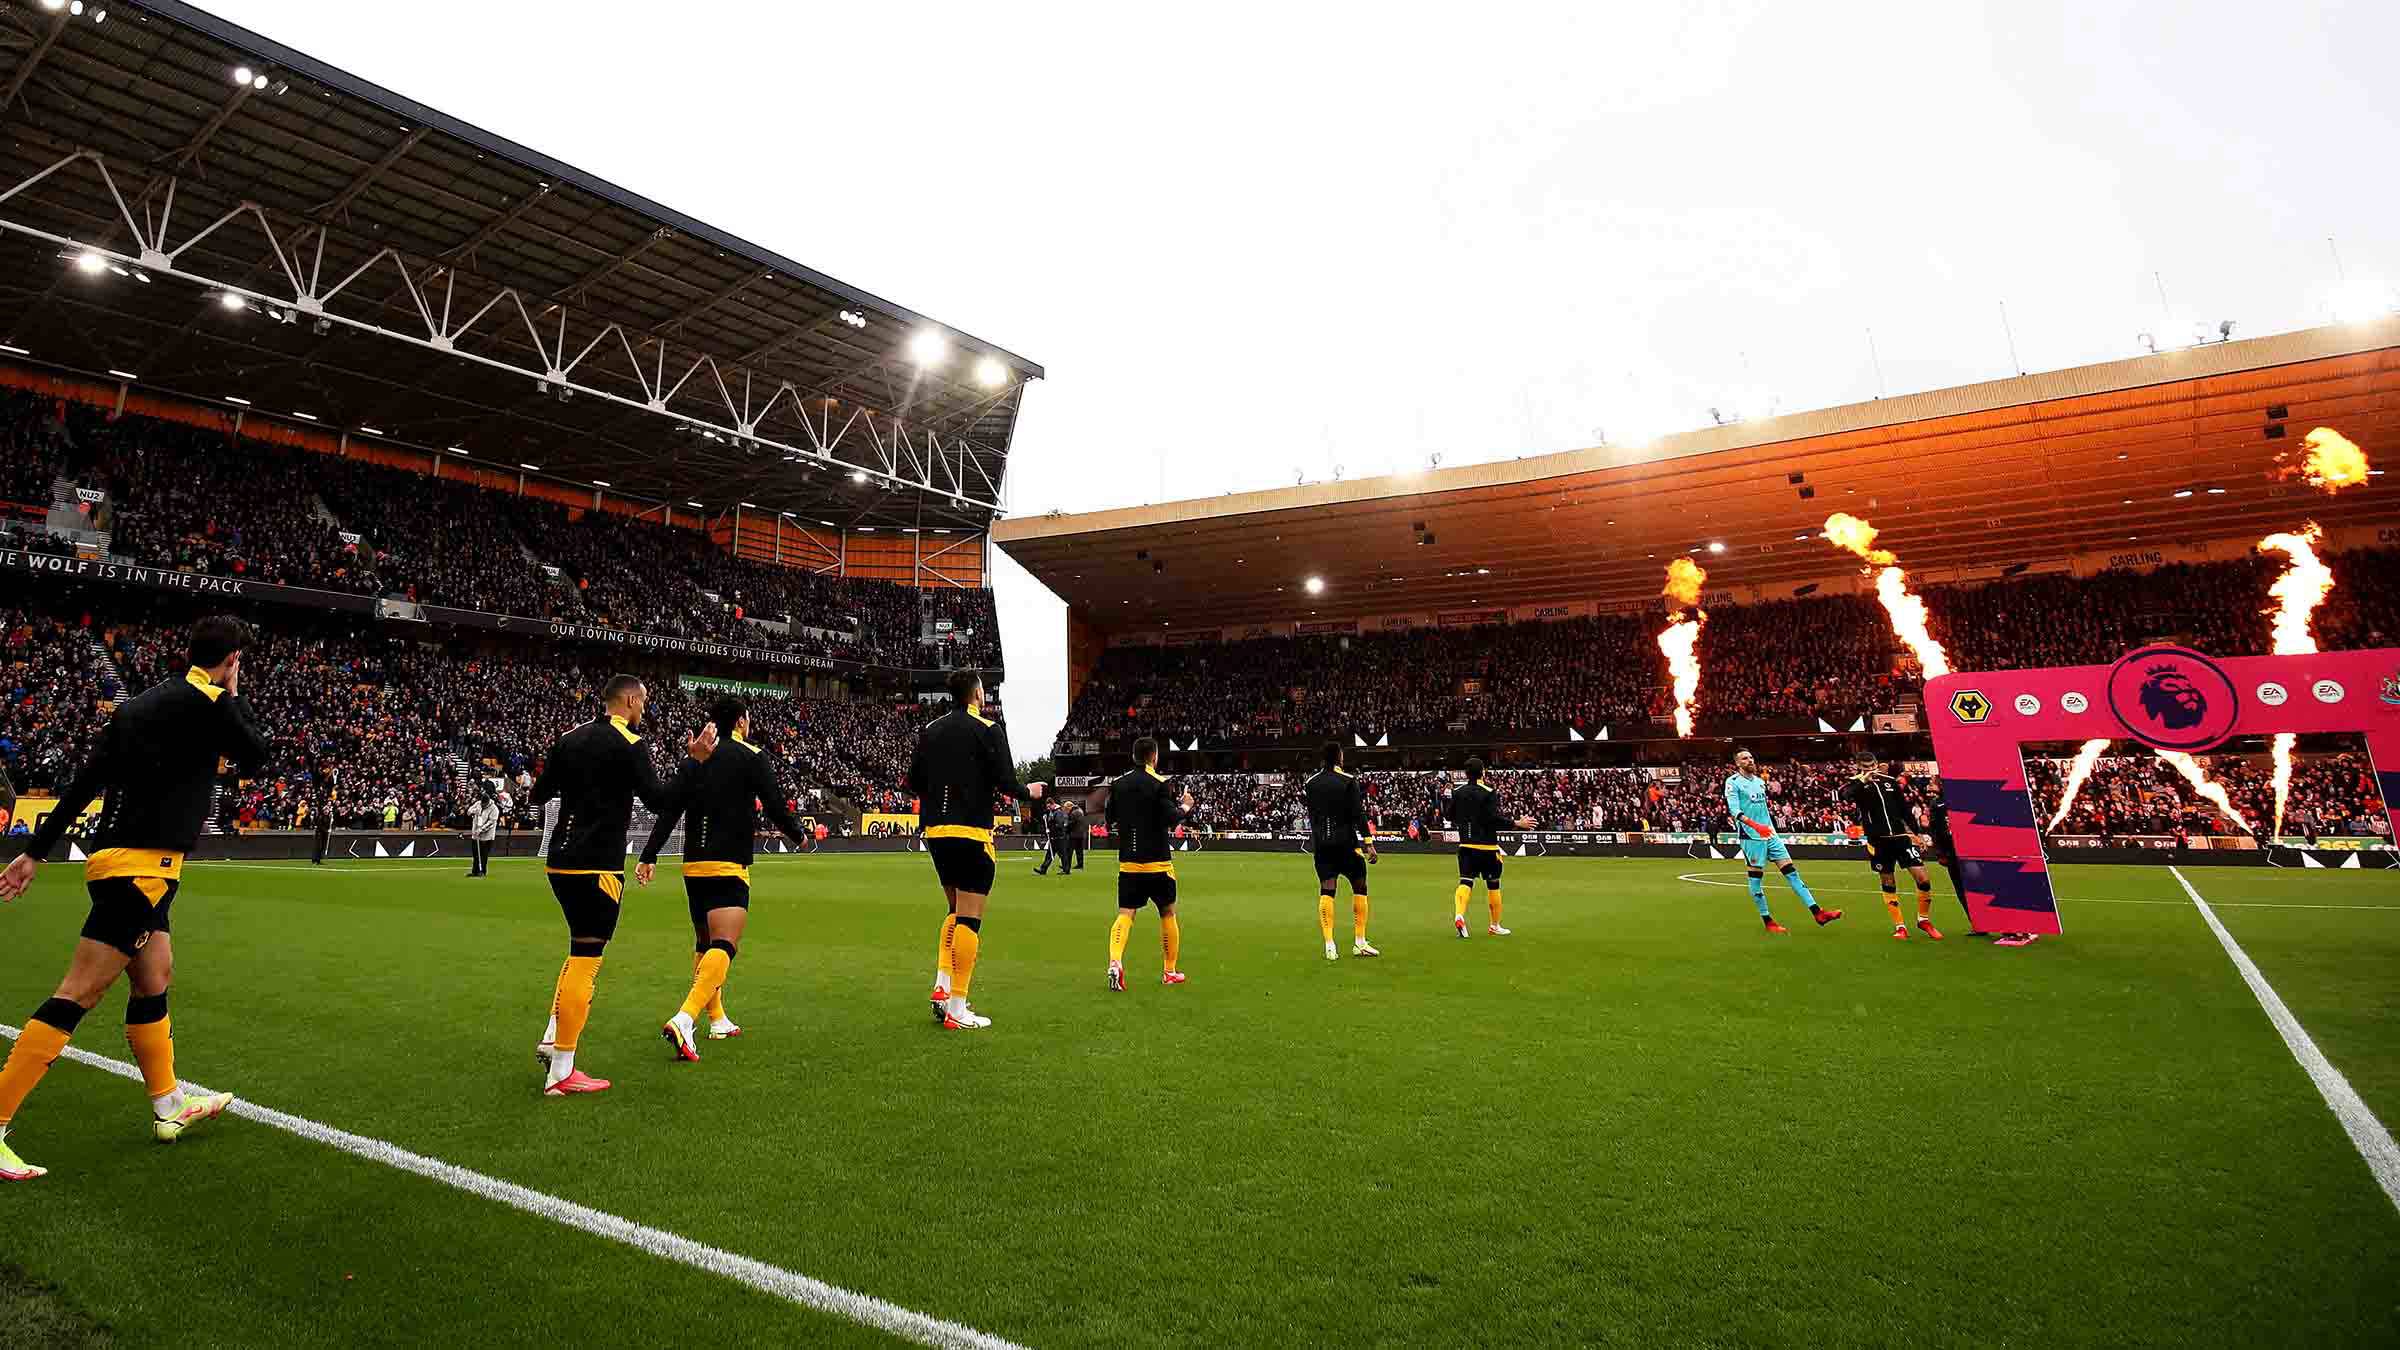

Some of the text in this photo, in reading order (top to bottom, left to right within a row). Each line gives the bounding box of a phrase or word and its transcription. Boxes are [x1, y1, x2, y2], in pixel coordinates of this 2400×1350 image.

[79, 490, 100, 500] NU2
[2110, 552, 2161, 567] CARLING
[28, 555, 88, 574] WOLF
[97, 565, 117, 579] IS
[127, 568, 148, 582] IN
[157, 572, 191, 588] THE
[199, 578, 243, 594] PACK
[1535, 607, 1569, 617] CARLING
[549, 624, 834, 670] OUR LOVING DEVOTION GUIDES OUR LIFELONG DREAM
[1057, 777, 1086, 786] CARLING
[1905, 846, 1920, 859] 16
